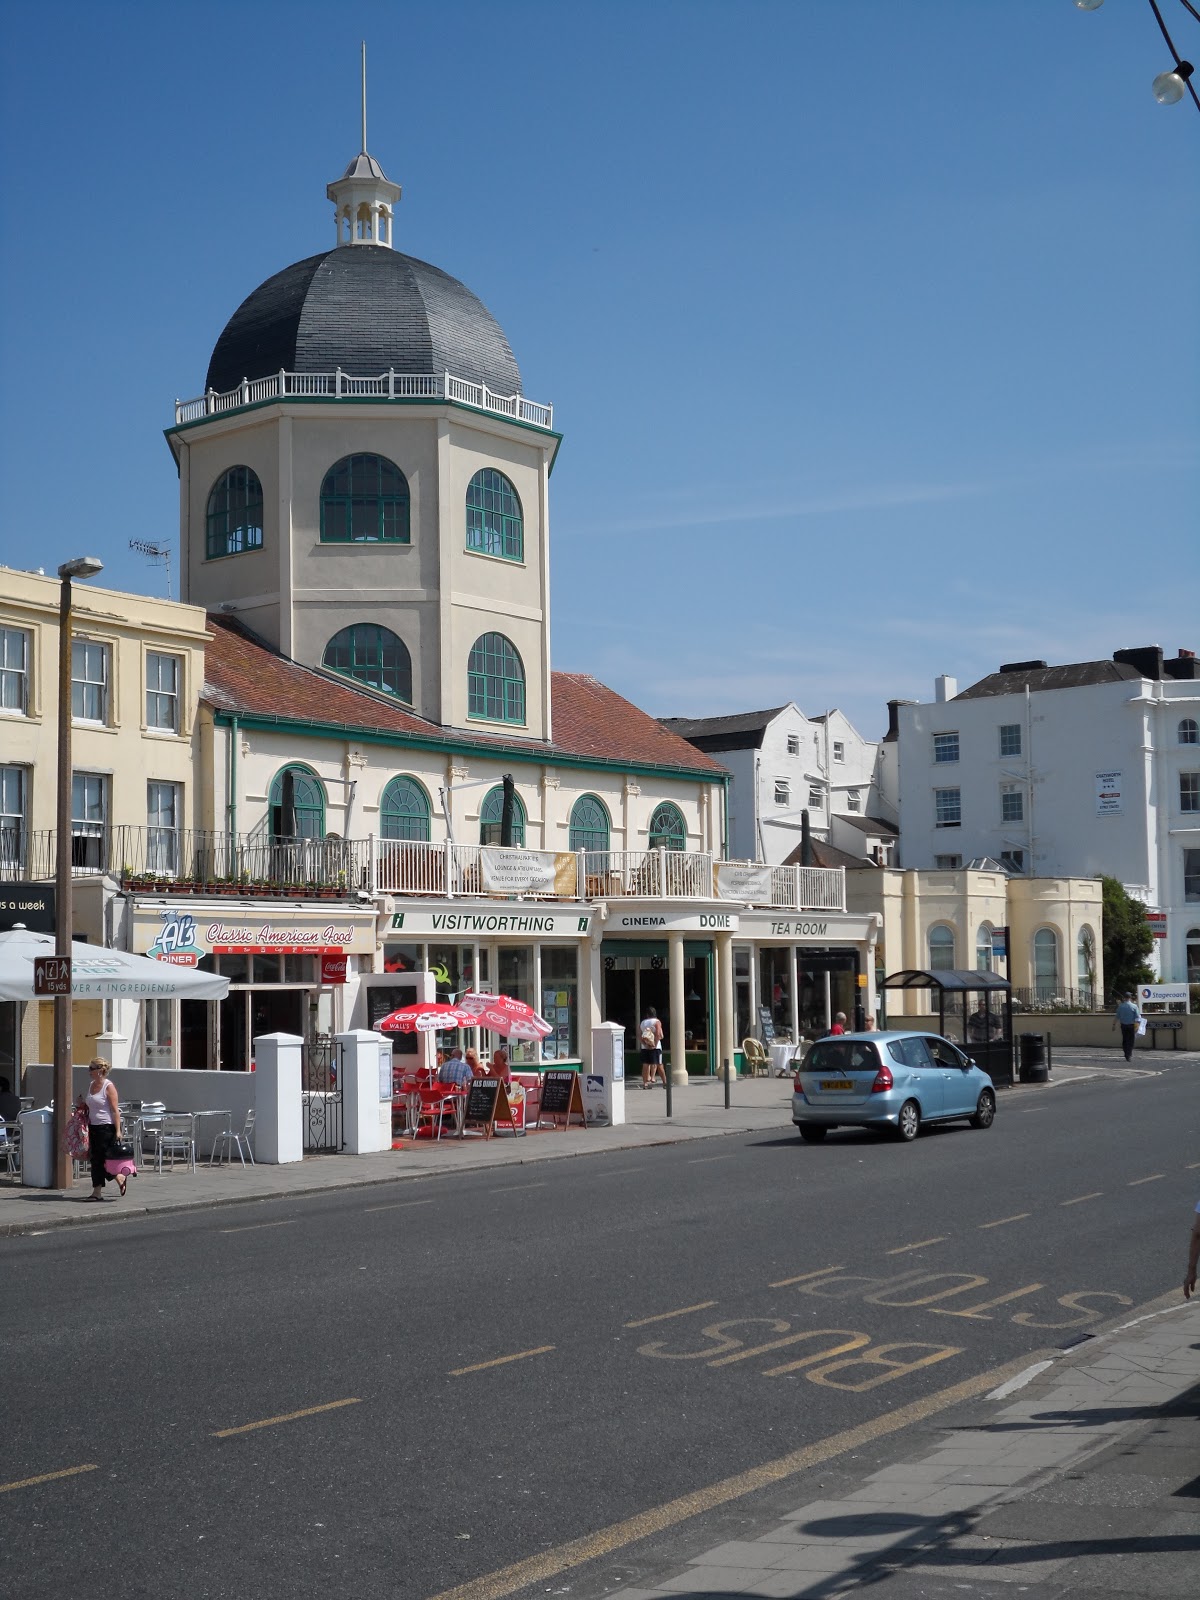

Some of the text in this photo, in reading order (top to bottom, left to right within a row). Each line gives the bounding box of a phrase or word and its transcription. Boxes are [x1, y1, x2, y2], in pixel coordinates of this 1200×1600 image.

[9, 902, 16, 910] a
[18, 900, 45, 910] week
[432, 914, 554, 931] VISITWORTHING
[622, 917, 666, 926] CINEMA
[700, 914, 730, 928] DOME
[206, 923, 355, 944] Classic American Food
[771, 922, 827, 935] TEA ROOM
[161, 955, 192, 964] DINER
[47, 982, 54, 990] 15
[55, 982, 67, 991] yds
[96, 984, 102, 992] 4
[107, 983, 176, 992] INGREDIENTS
[505, 1002, 527, 1013] WALL'S
[798, 1268, 1134, 1329] STOP
[637, 1317, 967, 1392] BUS
